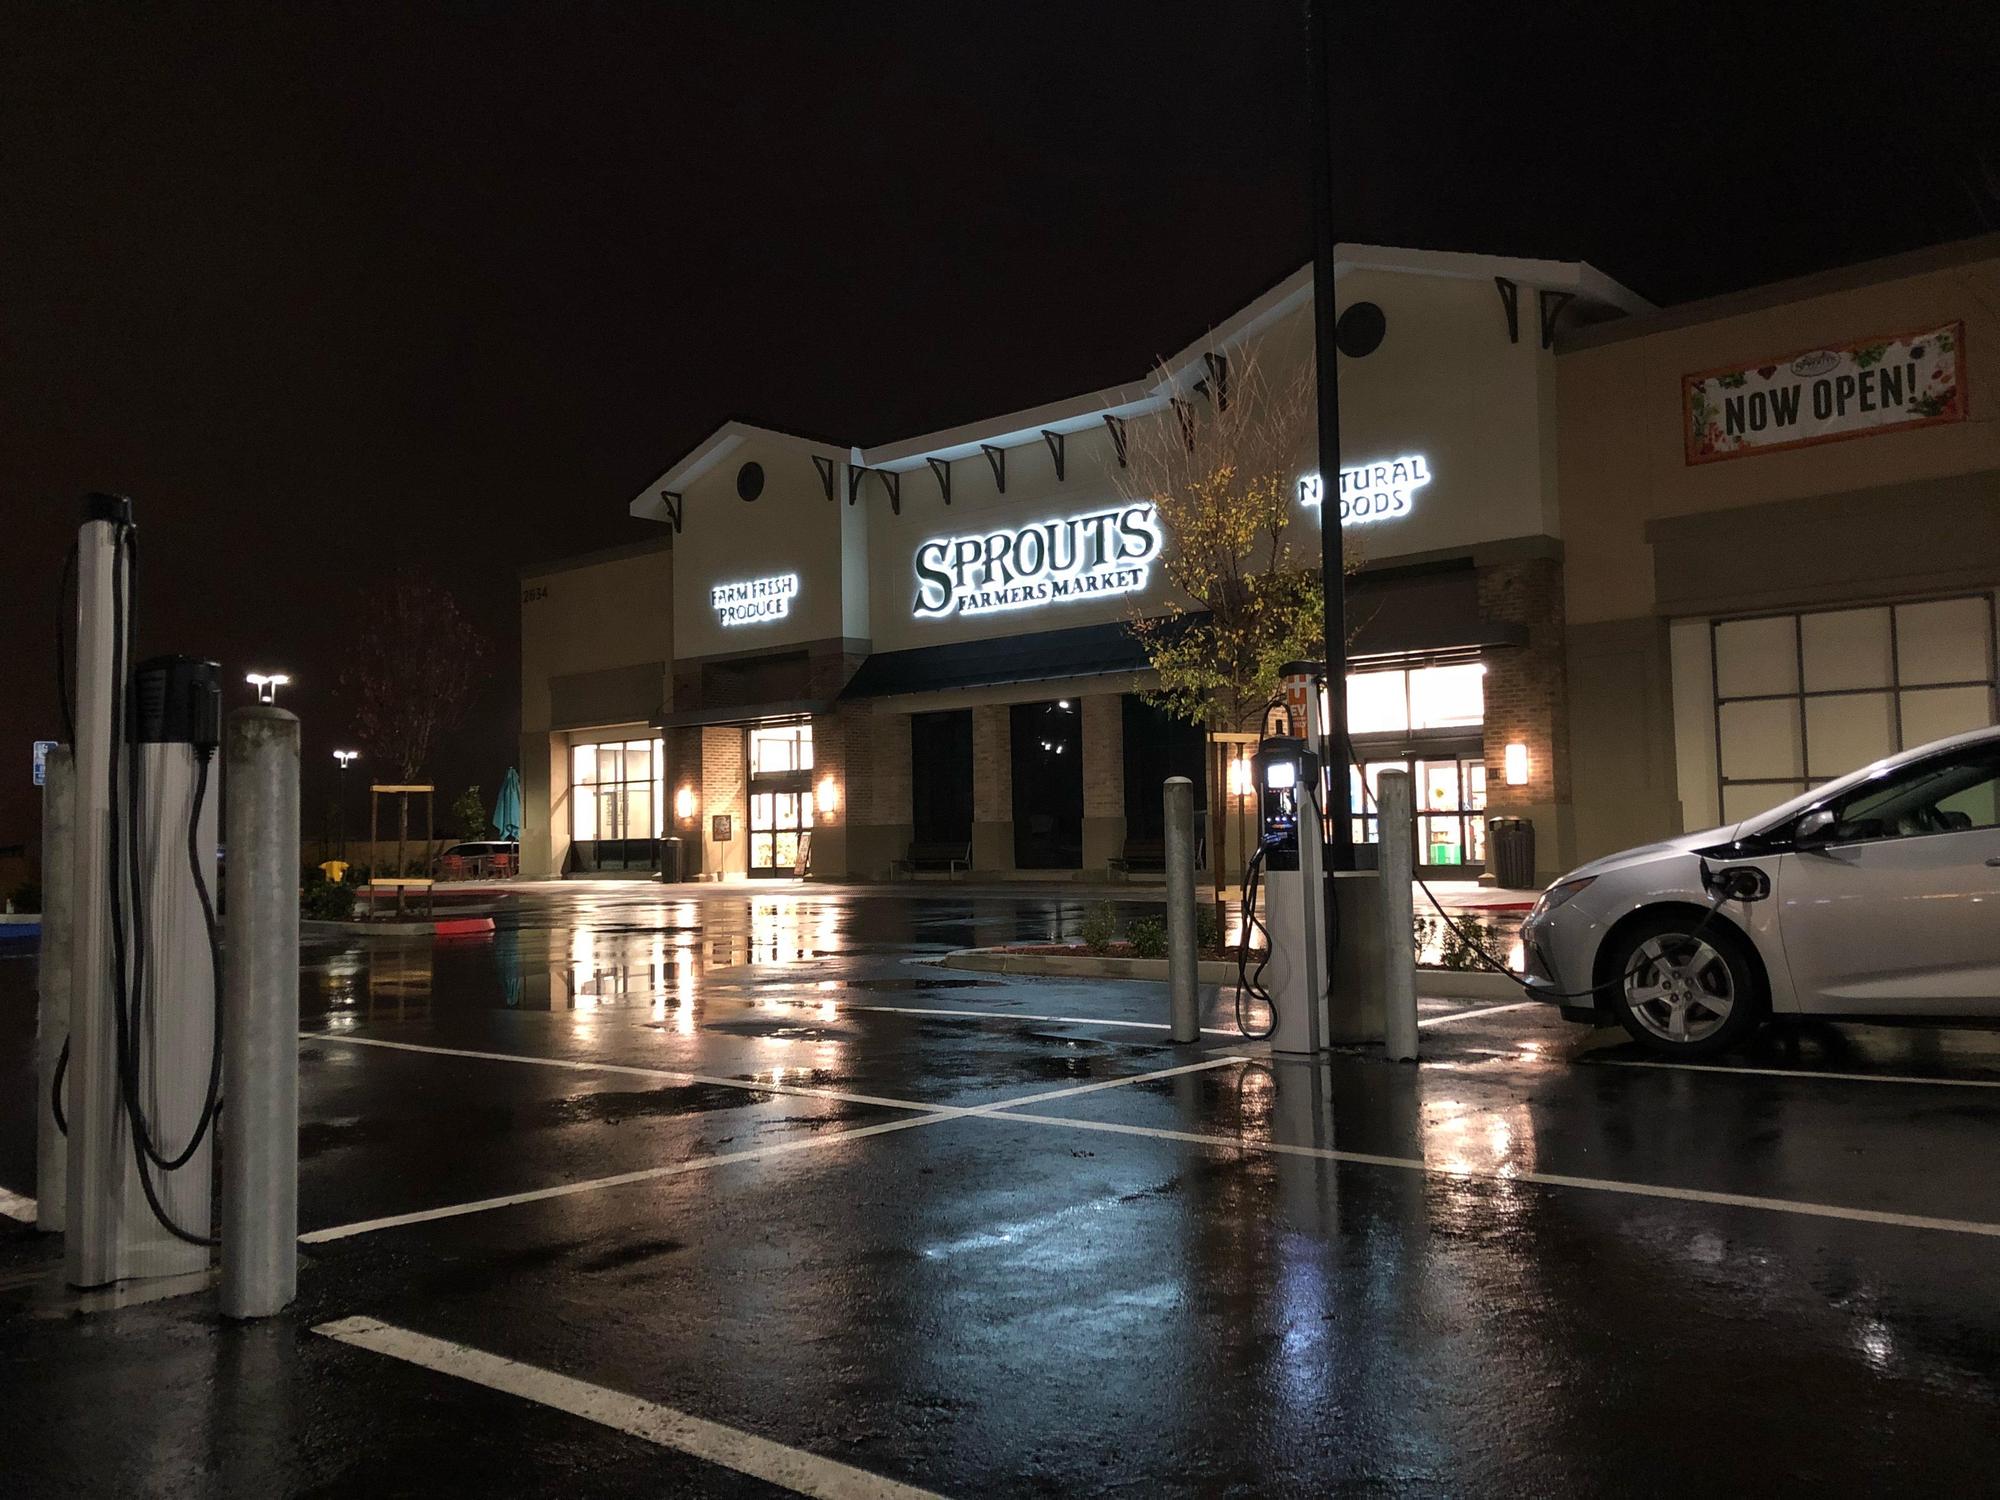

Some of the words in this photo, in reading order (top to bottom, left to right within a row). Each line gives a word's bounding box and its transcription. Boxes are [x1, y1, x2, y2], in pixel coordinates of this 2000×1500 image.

[1725, 384, 1801, 435] NOW
[1813, 363, 1916, 420] OPEN!
[1300, 460, 1425, 501] NTURAL
[1339, 490, 1404, 519] OODS
[913, 506, 1154, 614] SPROUTS
[711, 588, 749, 606] FARM
[752, 577, 793, 598] FRESH
[958, 584, 1047, 611] FARMERS
[1051, 568, 1143, 600] MARKET
[720, 598, 784, 623] PRODUCE
[1290, 704, 1306, 716] EV
